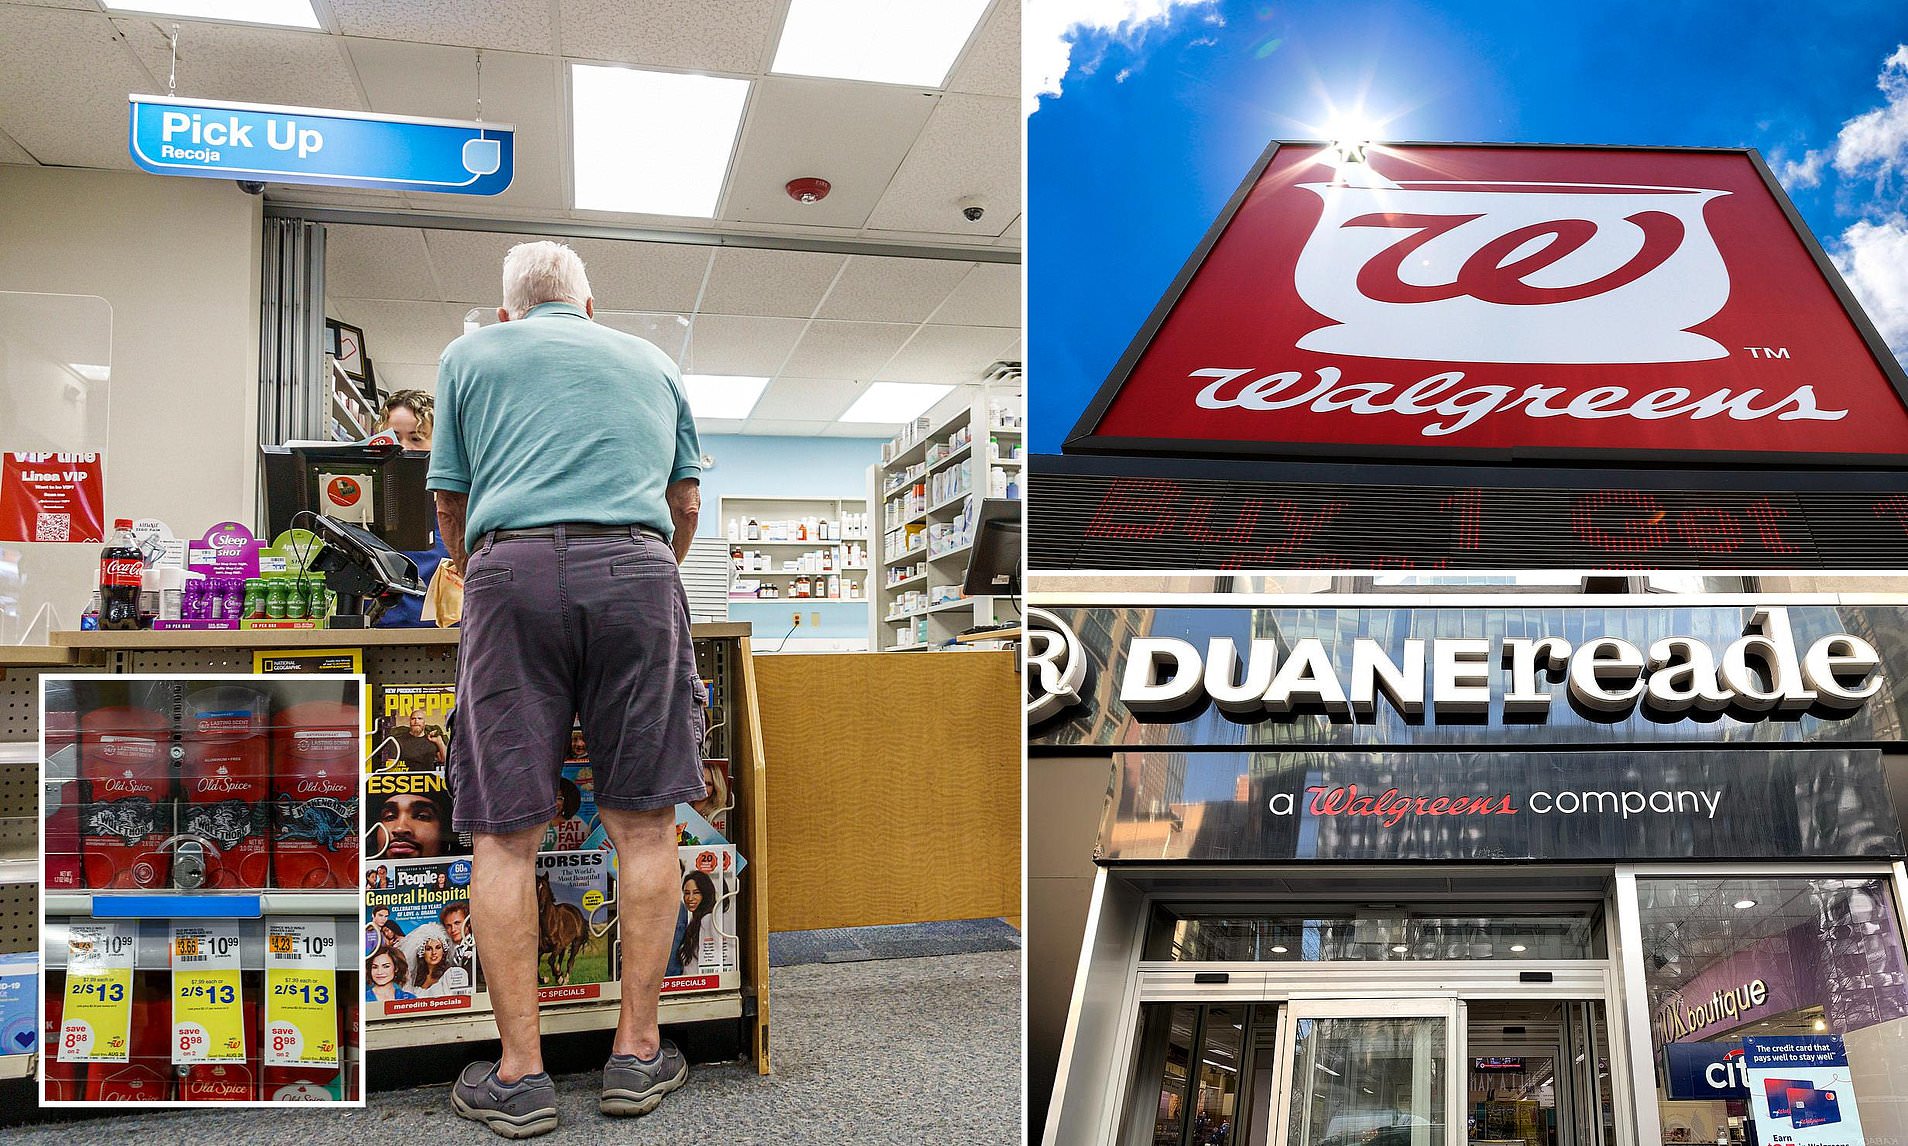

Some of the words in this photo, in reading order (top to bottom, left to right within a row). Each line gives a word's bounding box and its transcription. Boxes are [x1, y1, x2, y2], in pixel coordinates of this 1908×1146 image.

[161, 111, 254, 149] Pick
[267, 119, 325, 159] Up
[161, 144, 221, 163] Recoja
[1188, 369, 1848, 436] Walgreens
[62, 471, 88, 482] VIP
[1084, 477, 1348, 563] Buy
[1571, 488, 1800, 553] Get
[217, 534, 248, 548] Sleep
[217, 549, 242, 557] SHOT
[105, 778, 125, 792] Old
[125, 779, 151, 794] Spice
[197, 777, 219, 793] Old
[219, 777, 249, 794] Spice
[297, 779, 318, 793] Old
[318, 780, 344, 794] Spice
[1268, 790, 1294, 818] a
[1306, 782, 1519, 828] Walgreens
[1528, 785, 1722, 821] company
[558, 820, 582, 832] FAT
[701, 854, 713, 863] 20
[397, 870, 438, 888] People
[557, 875, 573, 883] Most
[573, 874, 600, 882] Beautiful
[568, 880, 590, 888] Animal
[366, 888, 415, 906] General
[417, 885, 471, 904] Hospital
[671, 978, 706, 988] SPECIALS
[548, 988, 586, 998] SPECIALS
[393, 1001, 428, 1010] meredith
[429, 998, 462, 1007] Specials
[1686, 978, 1769, 1034] boutique
[178, 1028, 200, 1036] save
[1756, 1044, 1771, 1052] The
[1771, 1043, 1794, 1052] credit
[1795, 1043, 1813, 1052] card
[1813, 1043, 1831, 1052] that
[1753, 1054, 1771, 1063] pays
[1772, 1053, 1788, 1062] well
[1789, 1053, 1798, 1061] to
[1799, 1053, 1814, 1063] stay
[190, 1080, 217, 1095] Old
[219, 1079, 248, 1096] Spice
[1773, 1134, 1793, 1142] Earn
